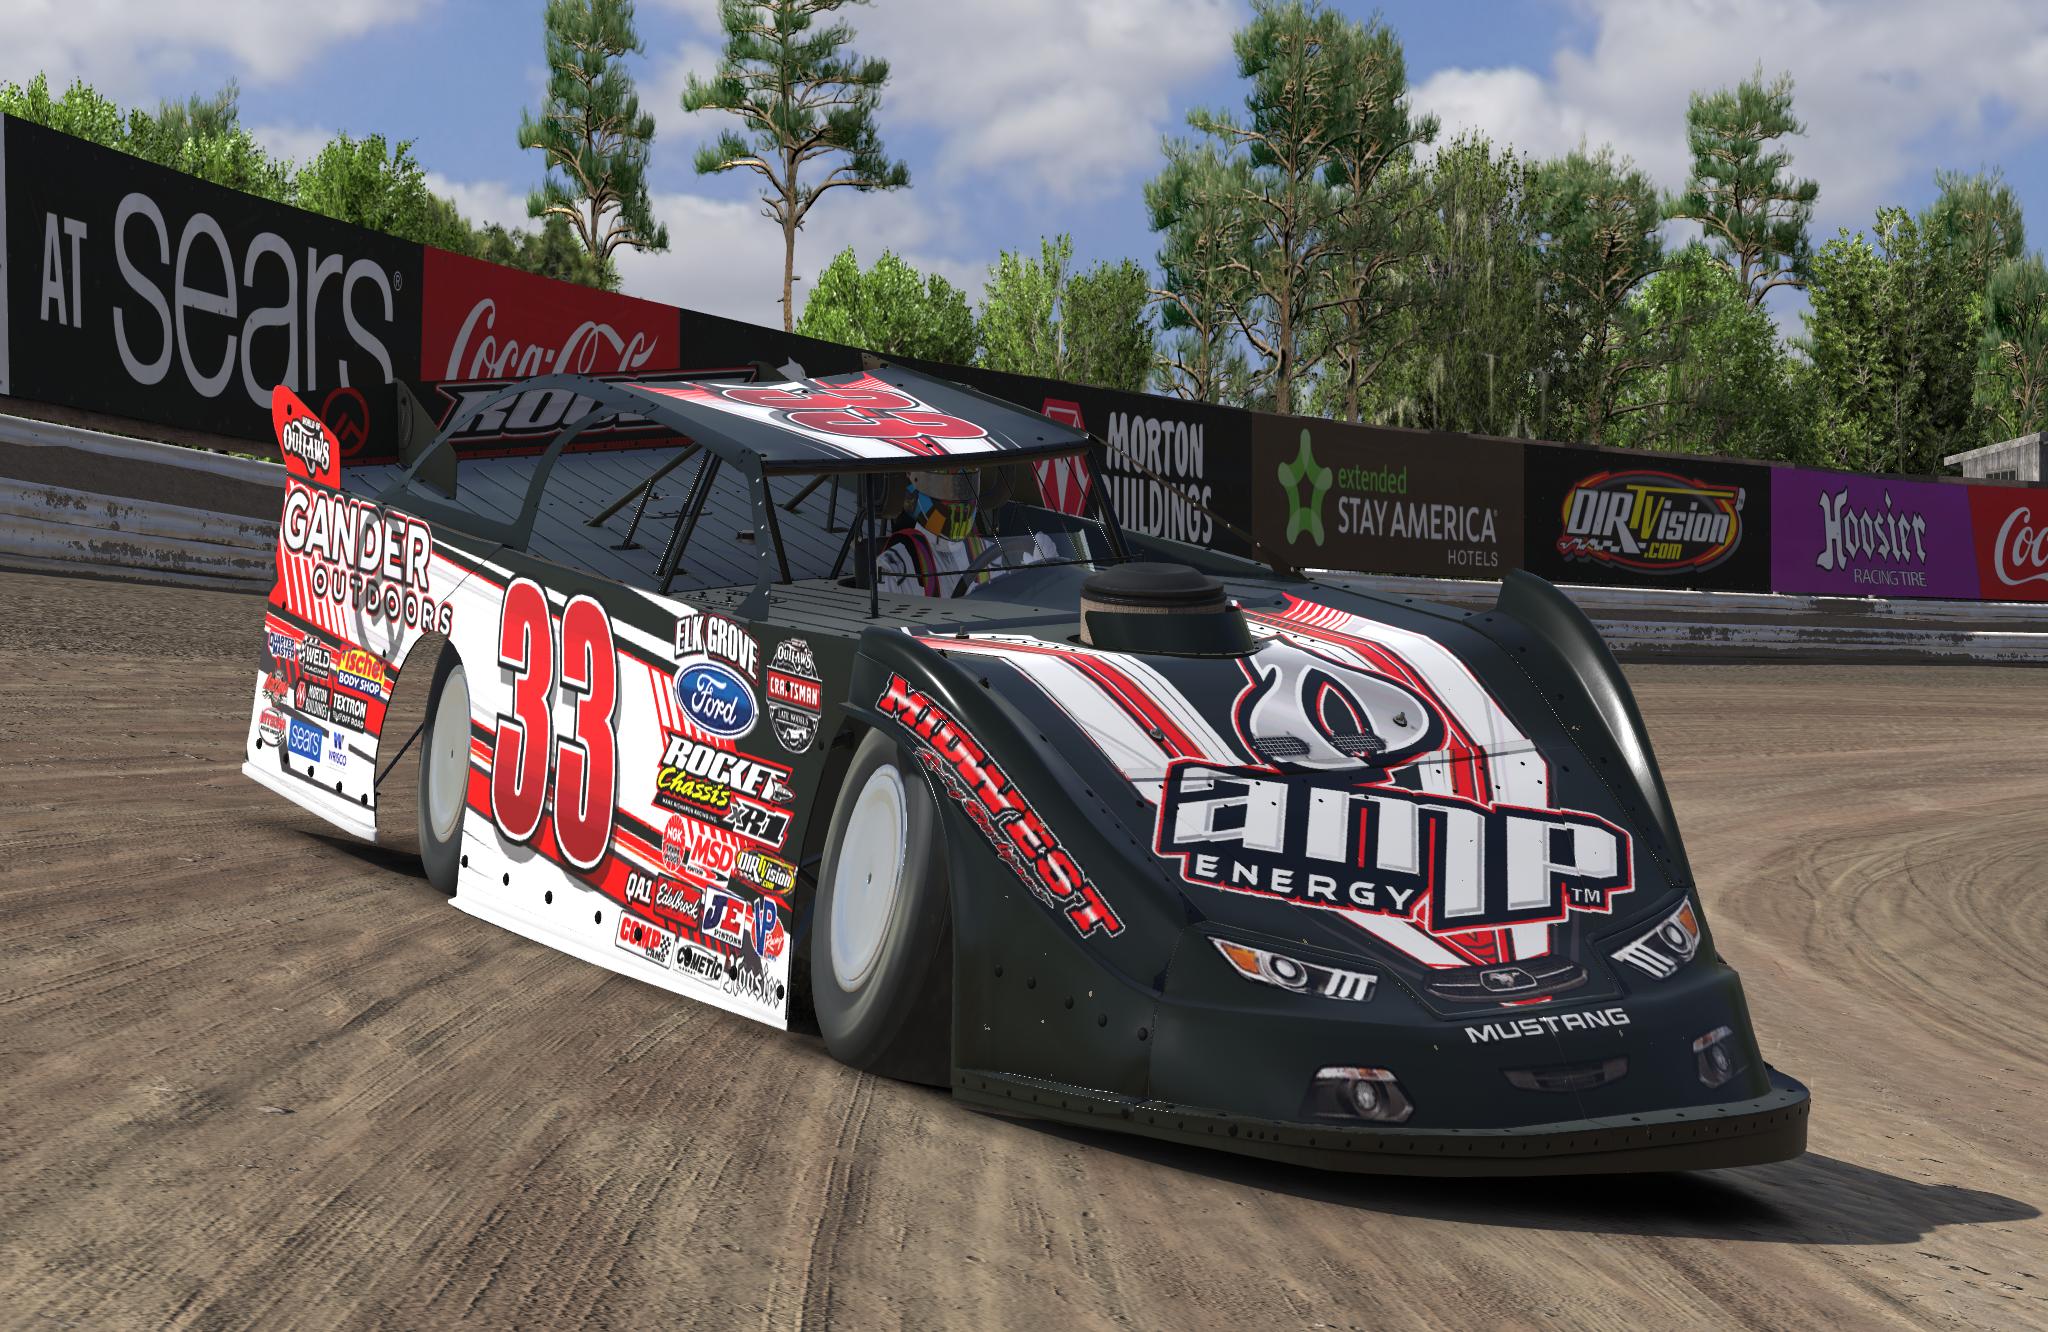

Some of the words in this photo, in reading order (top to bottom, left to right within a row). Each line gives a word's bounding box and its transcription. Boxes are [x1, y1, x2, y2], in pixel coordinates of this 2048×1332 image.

[41, 212, 87, 327] AT
[1106, 411, 1203, 480] MORTON
[1338, 464, 1407, 494] extended
[1338, 496, 1388, 536] STAY
[1390, 501, 1497, 543] AMERICA
[1816, 487, 1926, 570] Hoosier
[284, 488, 430, 590] GANDER
[1644, 541, 1683, 560] .com
[1447, 549, 1498, 567] HOTELS
[1854, 568, 1899, 585] RACING
[1899, 571, 1927, 587] TIRE
[312, 566, 453, 634] OUTDOORS
[269, 633, 295, 648] QUARTER
[272, 644, 295, 659] MASTER
[306, 645, 330, 668] WELD
[676, 614, 705, 655] ELK
[707, 615, 758, 680] GROVE
[308, 684, 328, 703] MORTON
[339, 671, 359, 688] BODY
[359, 680, 380, 695] SHOP
[691, 673, 738, 725] Ford
[333, 693, 367, 719] TEXTRON
[342, 713, 351, 724] OFF
[350, 717, 364, 729] ROAD
[491, 577, 618, 870] 33
[291, 725, 320, 755] sears
[662, 735, 787, 801] ROCKET
[657, 767, 731, 807] Chassis
[878, 673, 1121, 935] MIDWEST
[666, 827, 683, 843] NGK
[690, 834, 734, 872] MSD
[626, 872, 652, 905] QA1
[1195, 854, 1414, 911] ENERGY
[656, 883, 700, 919] Edelbrock
[702, 894, 745, 936] JE
[620, 917, 662, 951] COMP
[754, 897, 777, 957] VP
[645, 947, 667, 963] CAMS
[1464, 1007, 1631, 1043] MUSTANG
